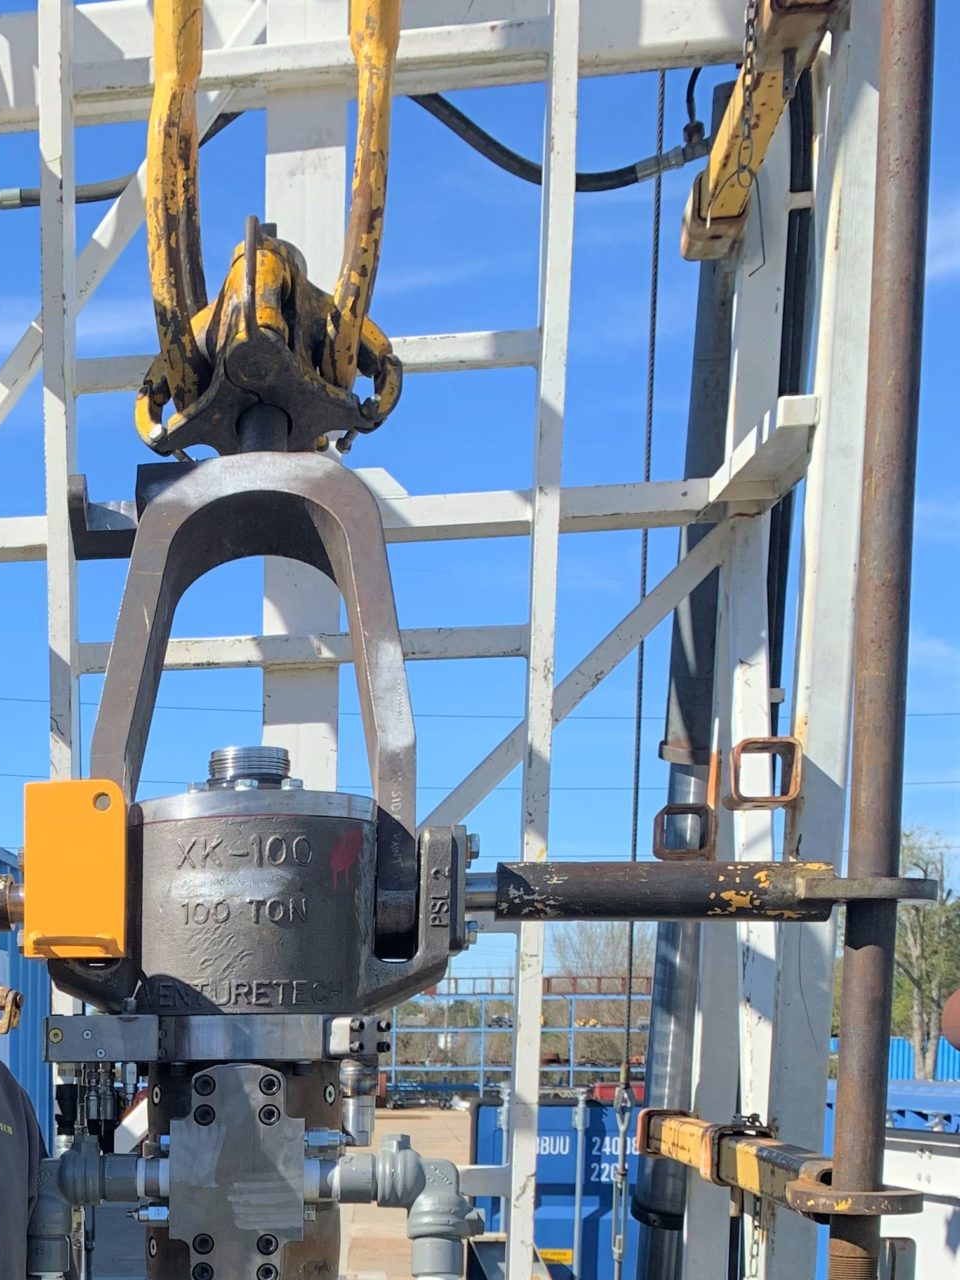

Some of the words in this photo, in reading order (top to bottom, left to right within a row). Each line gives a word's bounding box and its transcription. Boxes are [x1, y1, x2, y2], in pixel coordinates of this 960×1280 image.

[176, 833, 313, 869] XK-100
[431, 865, 451, 880] 2
[181, 899, 231, 925] 100
[246, 897, 308, 925] TON
[430, 890, 450, 928] PSL
[140, 980, 343, 1007] VENTURETECH
[535, 1136, 570, 1155] BUU
